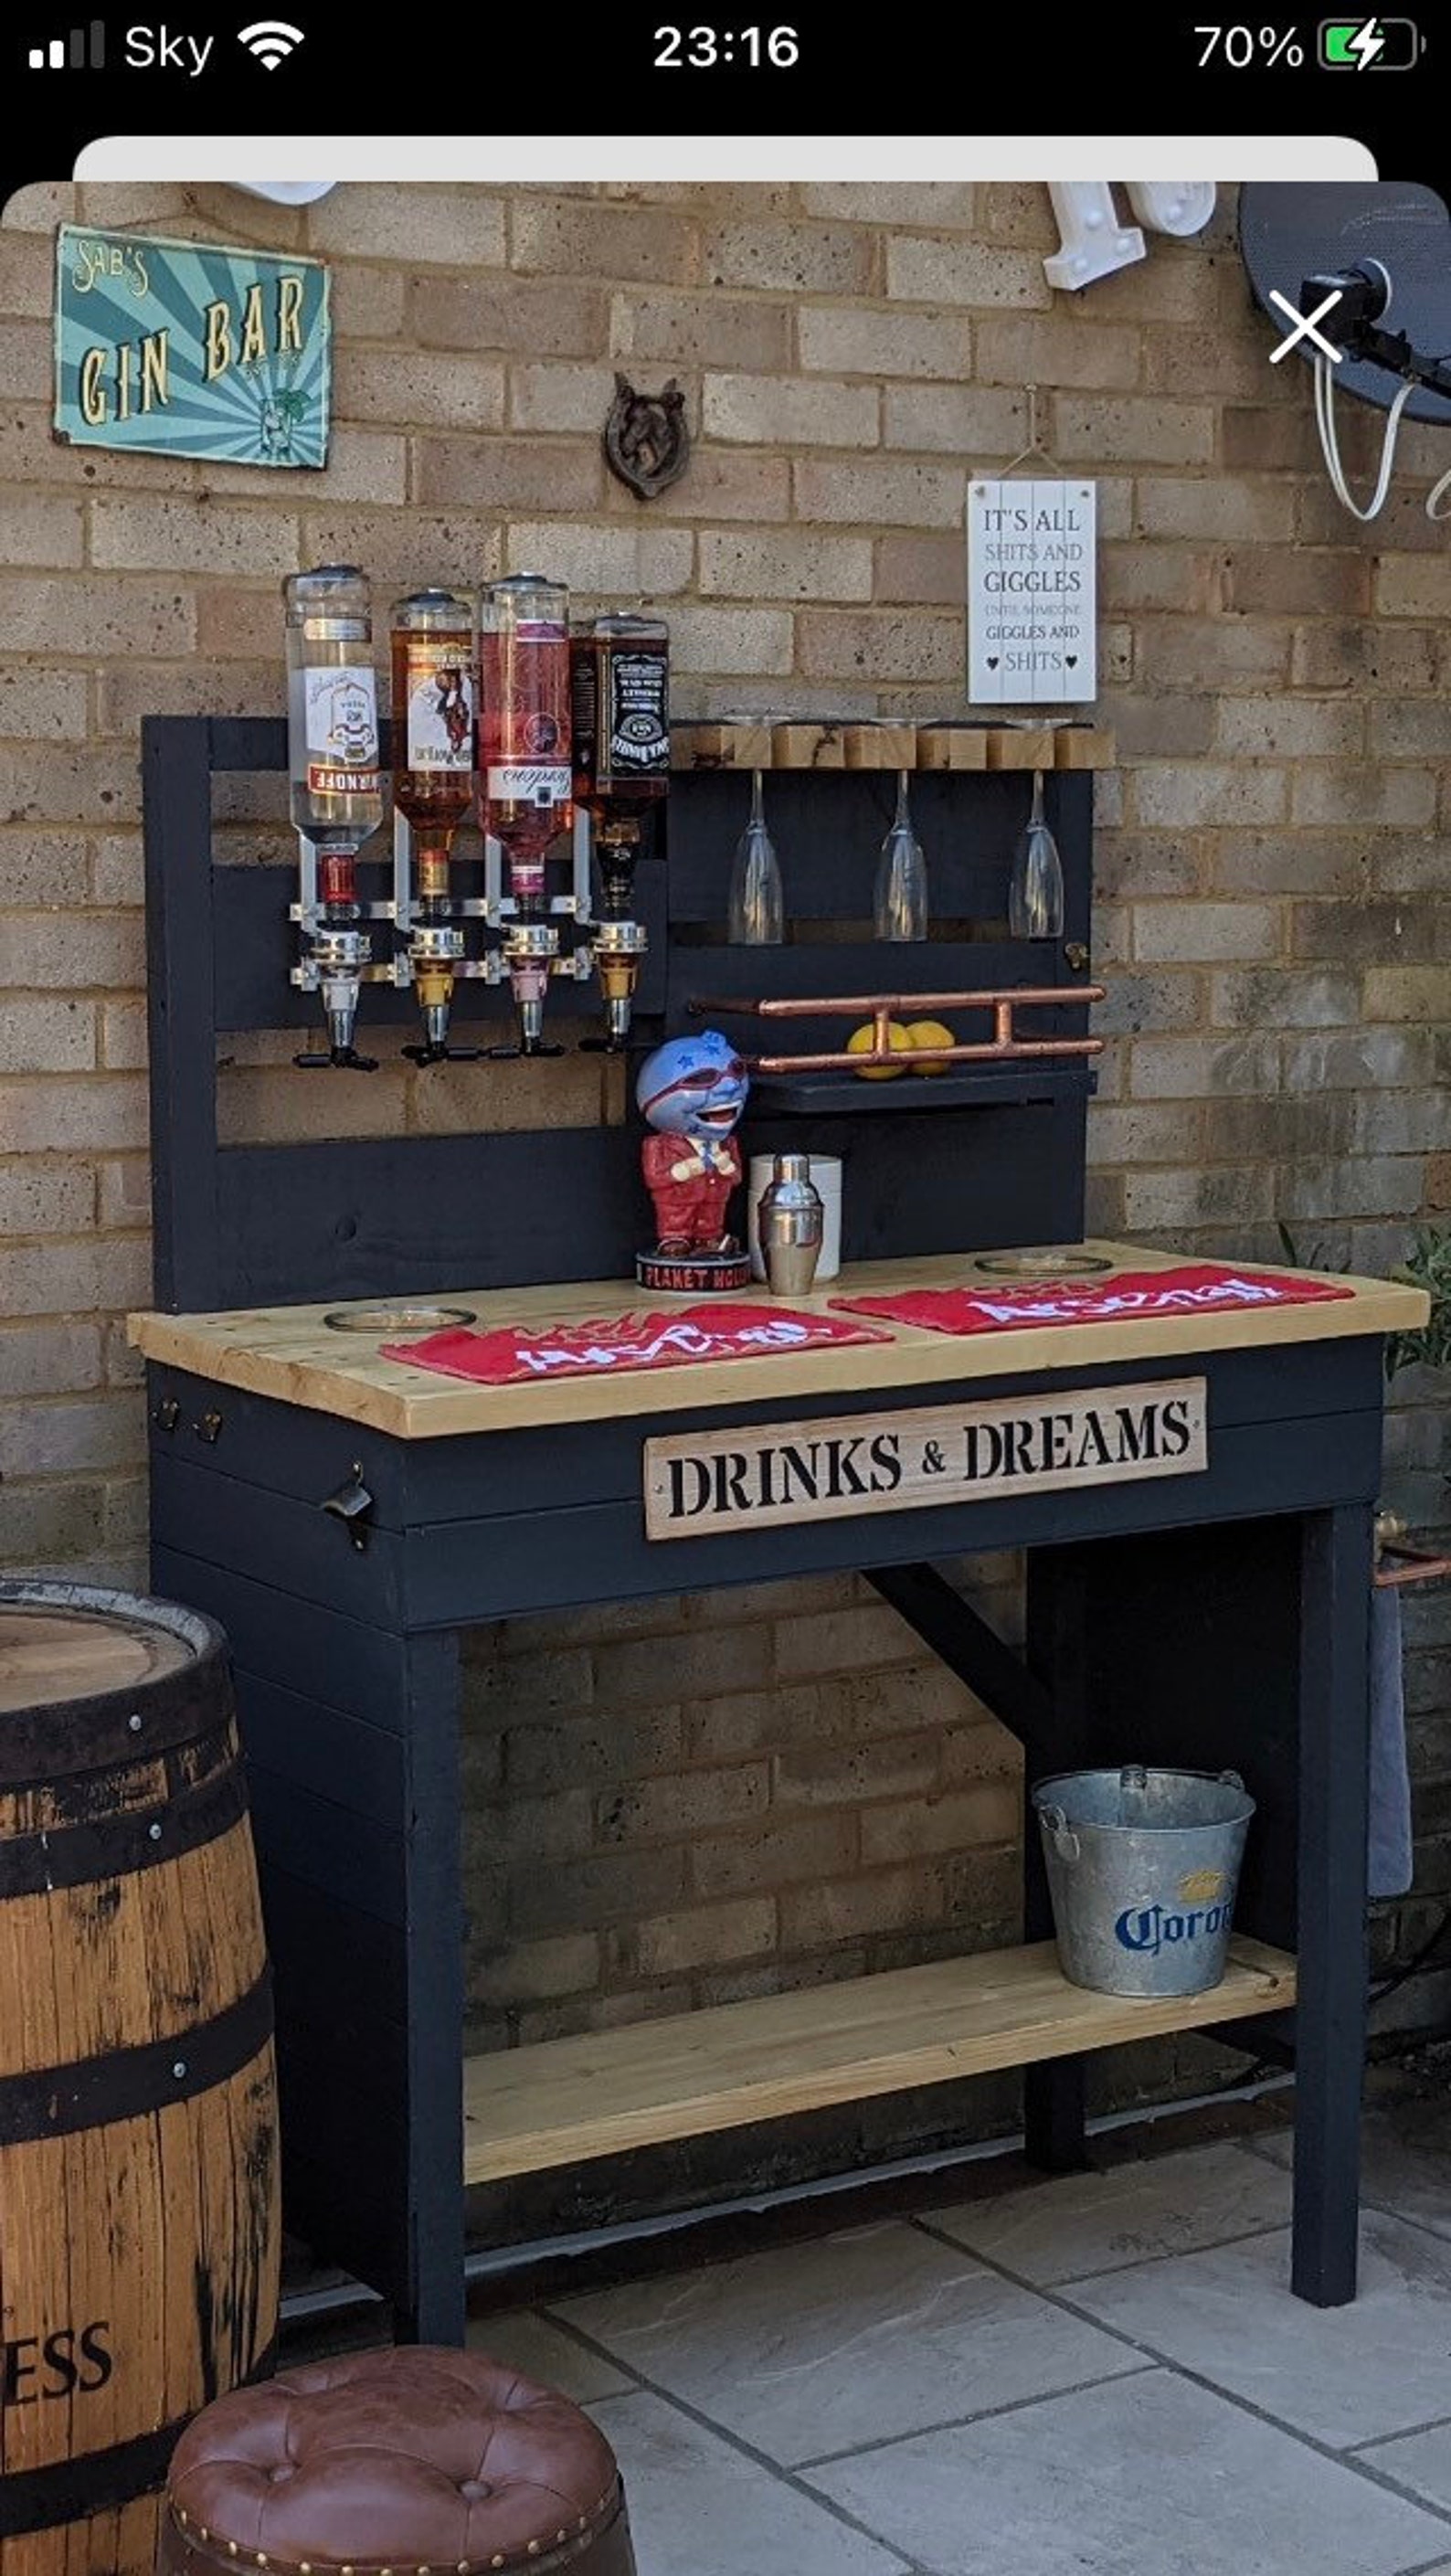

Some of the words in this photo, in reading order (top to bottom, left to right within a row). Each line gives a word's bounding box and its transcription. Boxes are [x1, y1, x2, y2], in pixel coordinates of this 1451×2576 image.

[71, 239, 148, 297] SAB'S
[79, 325, 171, 427] GIN
[202, 274, 303, 384] BAR
[984, 509, 1028, 532] IT'S
[1035, 509, 1081, 532] ALL
[985, 544, 1039, 561] SHITS
[1043, 543, 1083, 561] AND
[984, 570, 1082, 593] GIGGLES
[985, 625, 1046, 640] GIGGLES
[1049, 625, 1081, 640] AND
[1005, 652, 1063, 672] SHITS
[645, 1267, 708, 1289] PLANET
[667, 1433, 900, 1520] DRINKS
[921, 1439, 948, 1476] &
[962, 1400, 1192, 1481] DREAMS
